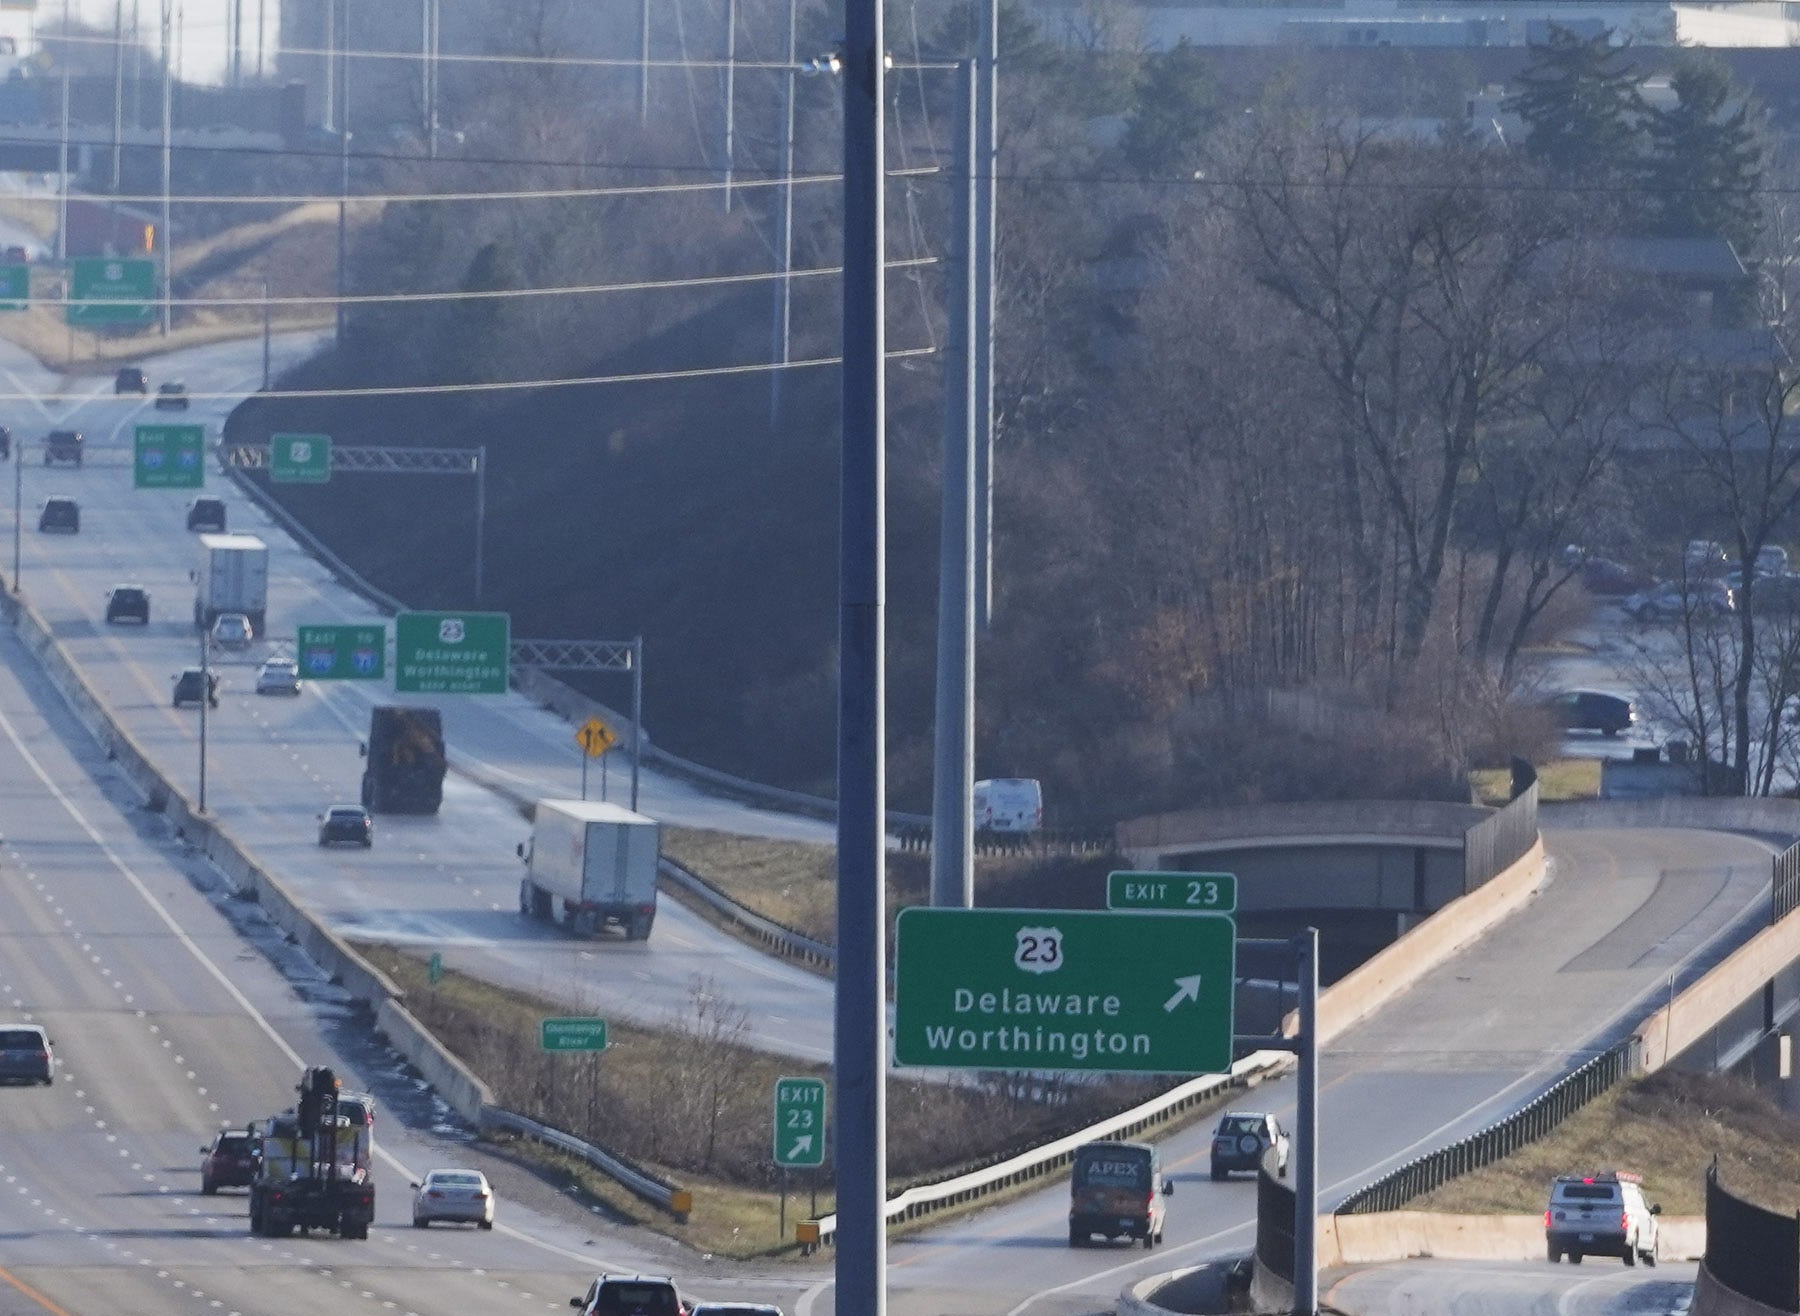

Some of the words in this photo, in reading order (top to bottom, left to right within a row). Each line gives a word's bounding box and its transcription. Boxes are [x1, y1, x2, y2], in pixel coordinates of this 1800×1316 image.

[415, 648, 488, 661] Delaware
[404, 665, 501, 681] Worthington
[1125, 883, 1168, 900] EXIT
[1186, 881, 1219, 905] 23
[1019, 935, 1059, 964] 23
[954, 987, 1121, 1016] Delaware
[925, 1025, 1151, 1060] Worthington
[780, 1087, 820, 1103] EXIT
[787, 1109, 814, 1129] 23
[1088, 1161, 1139, 1176] APEX
